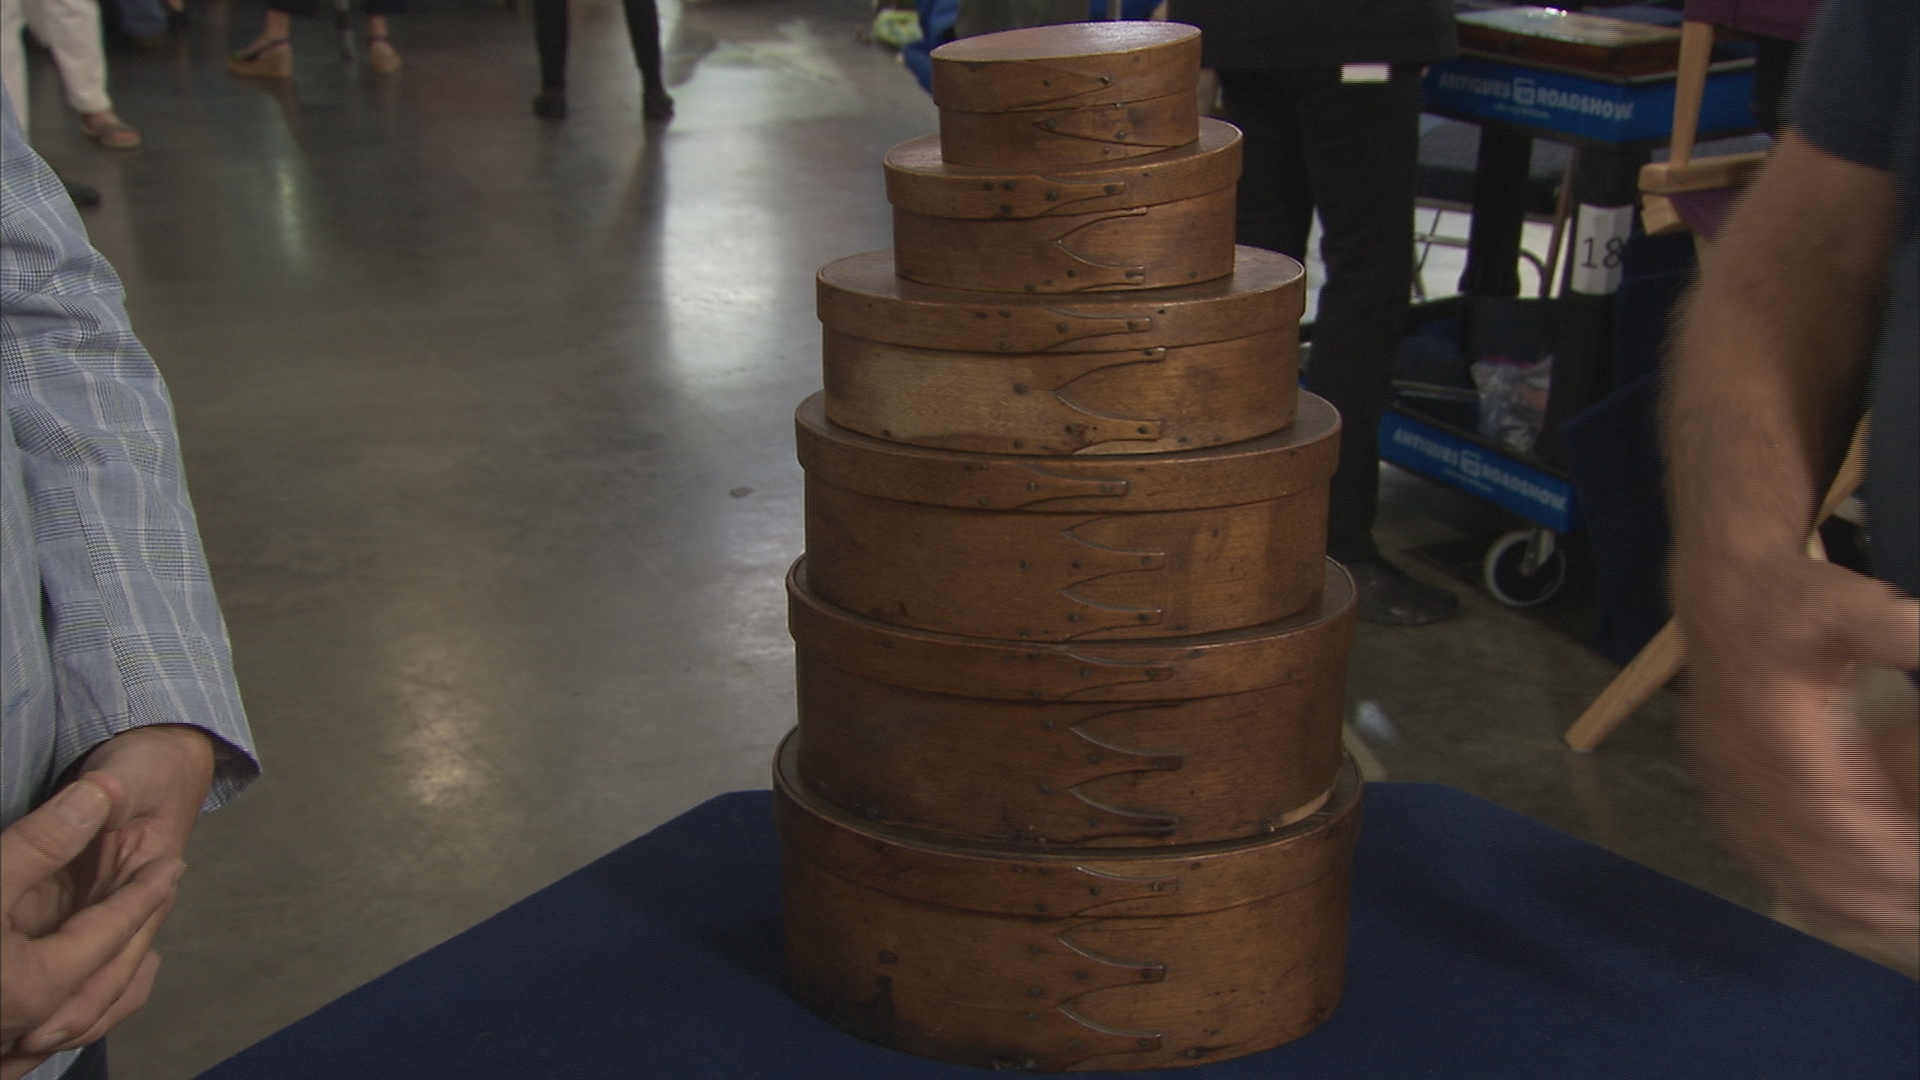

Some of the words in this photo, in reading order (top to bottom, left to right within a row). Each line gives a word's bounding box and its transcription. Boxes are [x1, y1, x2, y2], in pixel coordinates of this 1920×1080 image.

[1438, 73, 1512, 99] ANTIQUES
[1537, 87, 1634, 120] ROADSHOW
[1581, 237, 1622, 269] 18
[1392, 429, 1459, 467] ANTIQUES
[1480, 463, 1568, 511] ROADSHOW
